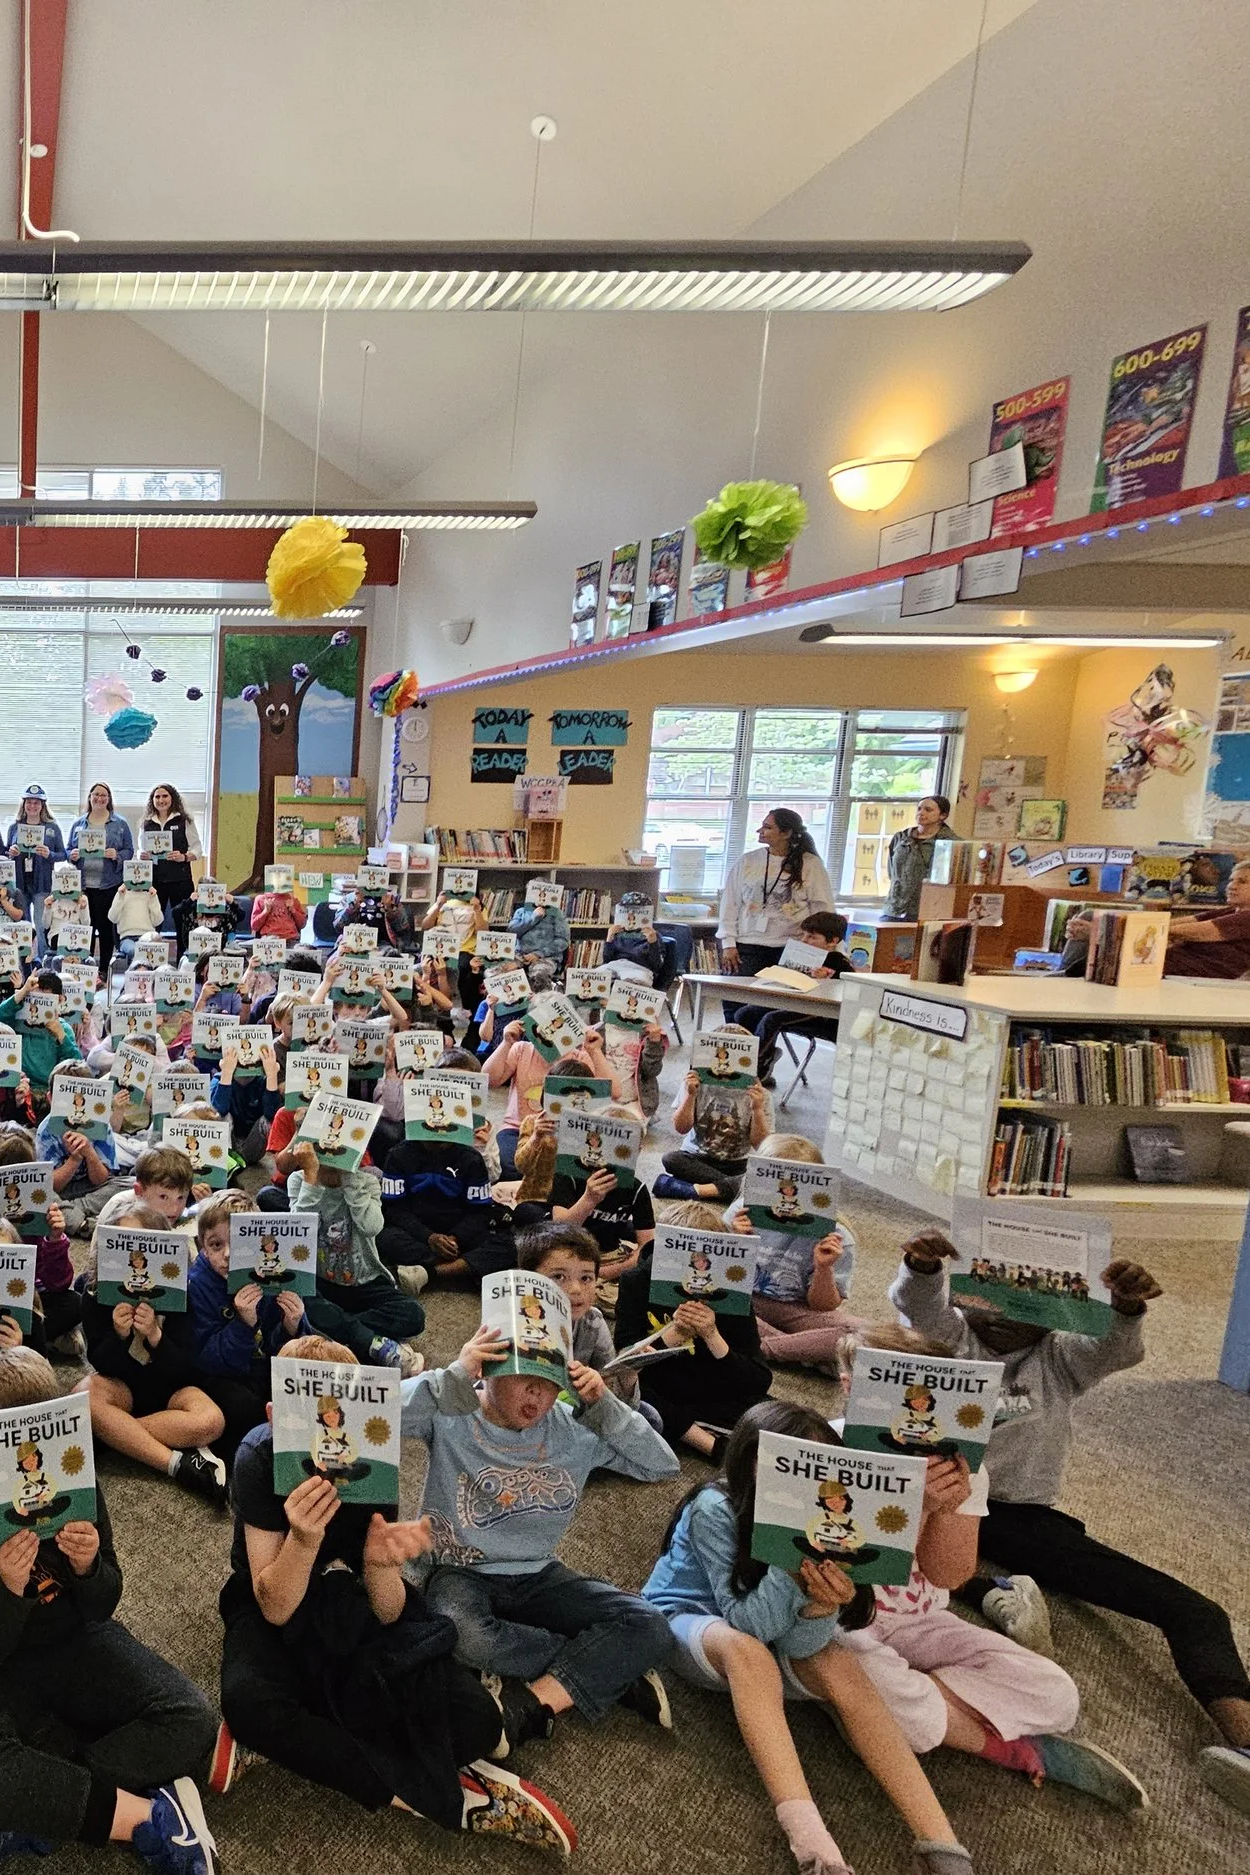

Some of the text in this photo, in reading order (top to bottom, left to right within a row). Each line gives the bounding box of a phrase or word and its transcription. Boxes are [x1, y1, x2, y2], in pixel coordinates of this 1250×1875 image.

[1114, 332, 1200, 378] 600-699
[996, 383, 1065, 420] 500-599
[1109, 449, 1179, 474] Technology
[472, 709, 534, 730] TODAY
[548, 711, 632, 730] TOMORROW
[494, 729, 507, 743] A
[583, 730, 595, 745] A
[471, 752, 529, 774] READER
[557, 751, 617, 776] LEADER
[1028, 856, 1061, 873] Today's
[1070, 850, 1103, 861] Library
[886, 997, 932, 1024] Kindness
[341, 1029, 386, 1040] SHE BUILT
[700, 1039, 752, 1051] SHE BUILT
[59, 1084, 106, 1097] SHE BUILT
[157, 1081, 205, 1090] SHE BUILT
[410, 1089, 465, 1100] SHE BUILT
[317, 1102, 371, 1121] SHE BUILT
[169, 1128, 222, 1139] SHE BUILT
[567, 1120, 632, 1139] SHE BUILT
[13, 1172, 46, 1185] BUILT
[756, 1167, 831, 1187] SHE BUILT
[239, 1226, 310, 1237] SHE BUILT
[695, 1234, 722, 1242] HOUSE
[106, 1239, 179, 1255] SHE BUILT
[664, 1240, 749, 1258] SHE BUILT
[492, 1285, 525, 1299] SHE
[300, 1369, 318, 1378] THE
[891, 1360, 913, 1369] THE
[916, 1362, 956, 1376] HOUSE
[868, 1367, 988, 1392] SHE BUILT
[284, 1378, 388, 1403] SHE BUILT
[20, 1412, 52, 1427] HOUSE
[29, 1417, 80, 1443] BUILT
[798, 1448, 823, 1461] THE
[828, 1452, 872, 1468] HOUSE
[774, 1456, 911, 1494] SHE BUILT
